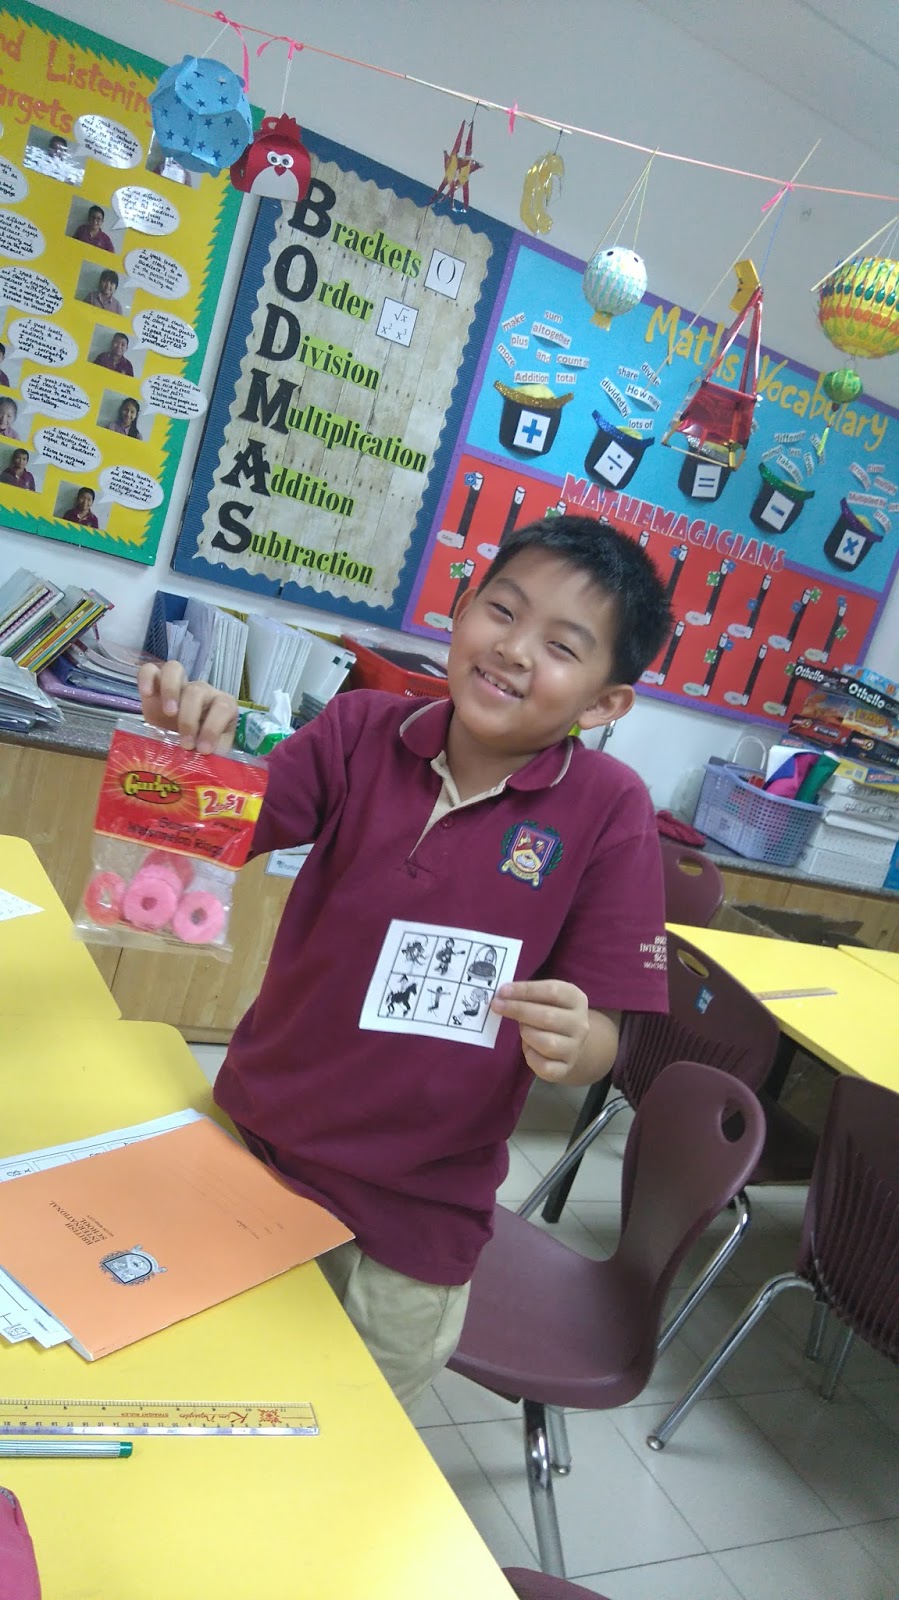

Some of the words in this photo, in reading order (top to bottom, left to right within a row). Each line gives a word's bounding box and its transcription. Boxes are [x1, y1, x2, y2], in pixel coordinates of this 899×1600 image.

[47, 39, 153, 127] Listenin
[287, 177, 421, 278] Brackets
[274, 245, 374, 320] Order
[502, 313, 526, 331] make
[545, 312, 562, 322] sum
[256, 303, 380, 390] Division
[532, 323, 570, 348] altogether
[497, 343, 516, 367] more
[515, 372, 549, 382] Addition
[557, 374, 576, 383] total
[618, 368, 638, 380] share
[239, 368, 427, 472] Multiplication
[629, 420, 642, 428] lots
[220, 438, 355, 516] Addition
[561, 472, 787, 573] MATHEMAGICIANS
[211, 500, 374, 584] Subtraction
[795, 665, 824, 682] Othello
[848, 683, 886, 709] Othello
[203, 789, 217, 815] 2
[49, 1200, 100, 1243] INTERNATIONAL
[80, 1218, 107, 1240] SCHOOL
